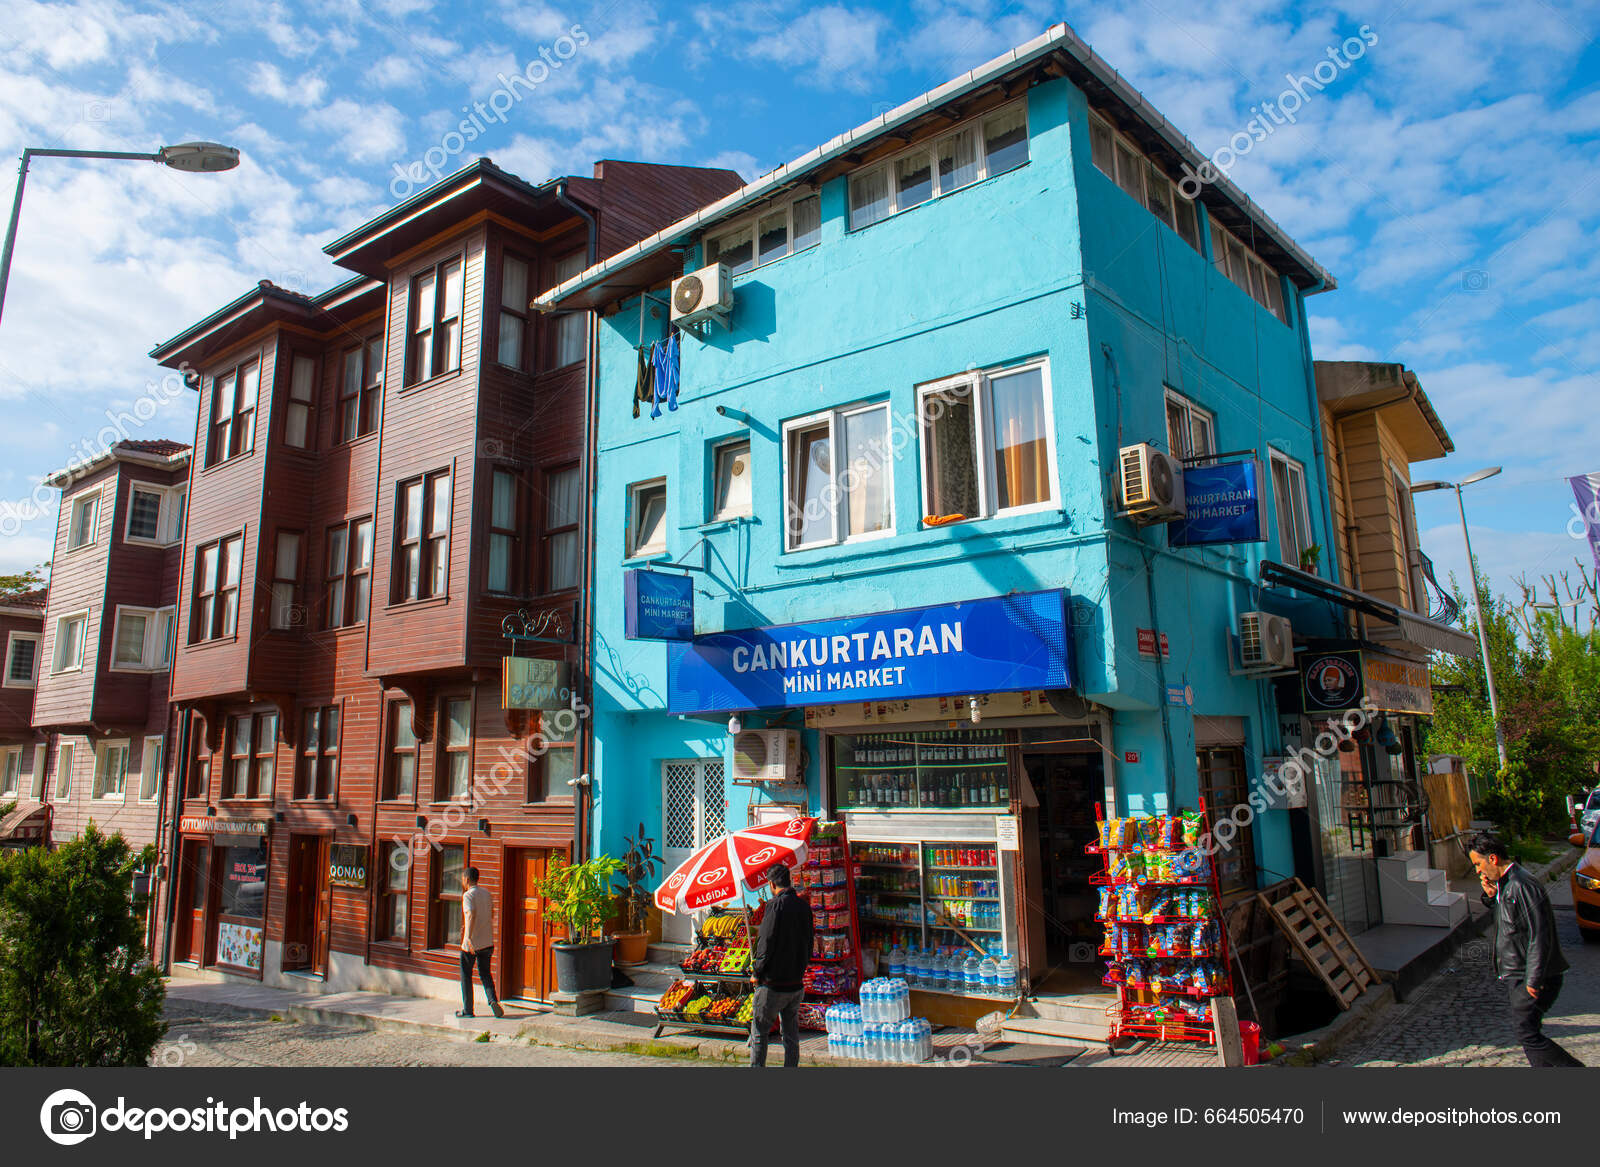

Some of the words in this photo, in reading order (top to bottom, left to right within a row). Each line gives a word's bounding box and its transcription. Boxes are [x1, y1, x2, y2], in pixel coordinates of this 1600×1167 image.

[1185, 489, 1251, 505] NKURTARAN
[1203, 505, 1246, 518] MARKET
[640, 594, 691, 608] CANKURTARAN
[661, 610, 689, 619] MARKET
[732, 621, 964, 674] CANKURTARAN
[827, 666, 906, 689] MARKET
[181, 818, 214, 831] OTTOMAN
